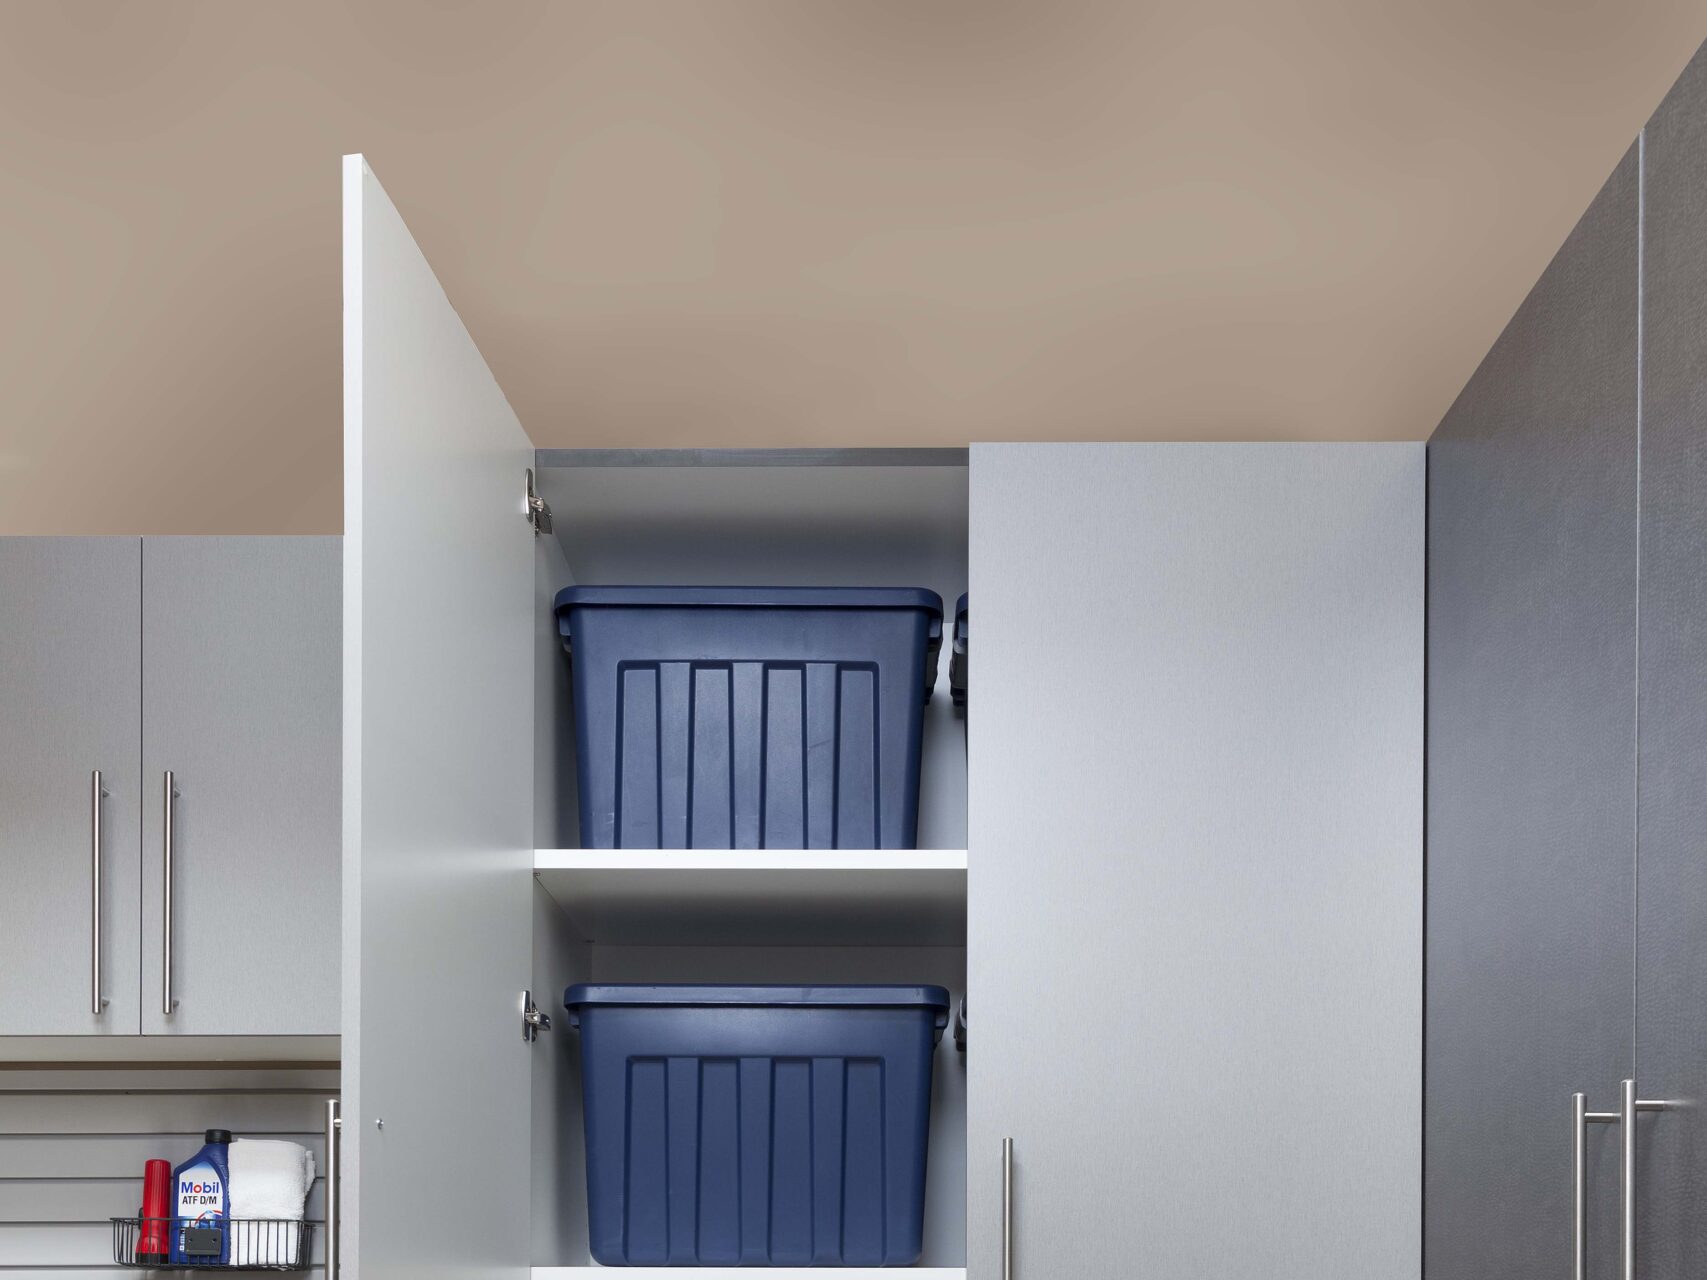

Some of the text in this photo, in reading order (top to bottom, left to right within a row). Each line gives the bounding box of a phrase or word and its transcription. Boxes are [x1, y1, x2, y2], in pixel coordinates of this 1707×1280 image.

[181, 1181, 219, 1193] Mobil
[182, 1196, 217, 1205] ATF D/M
